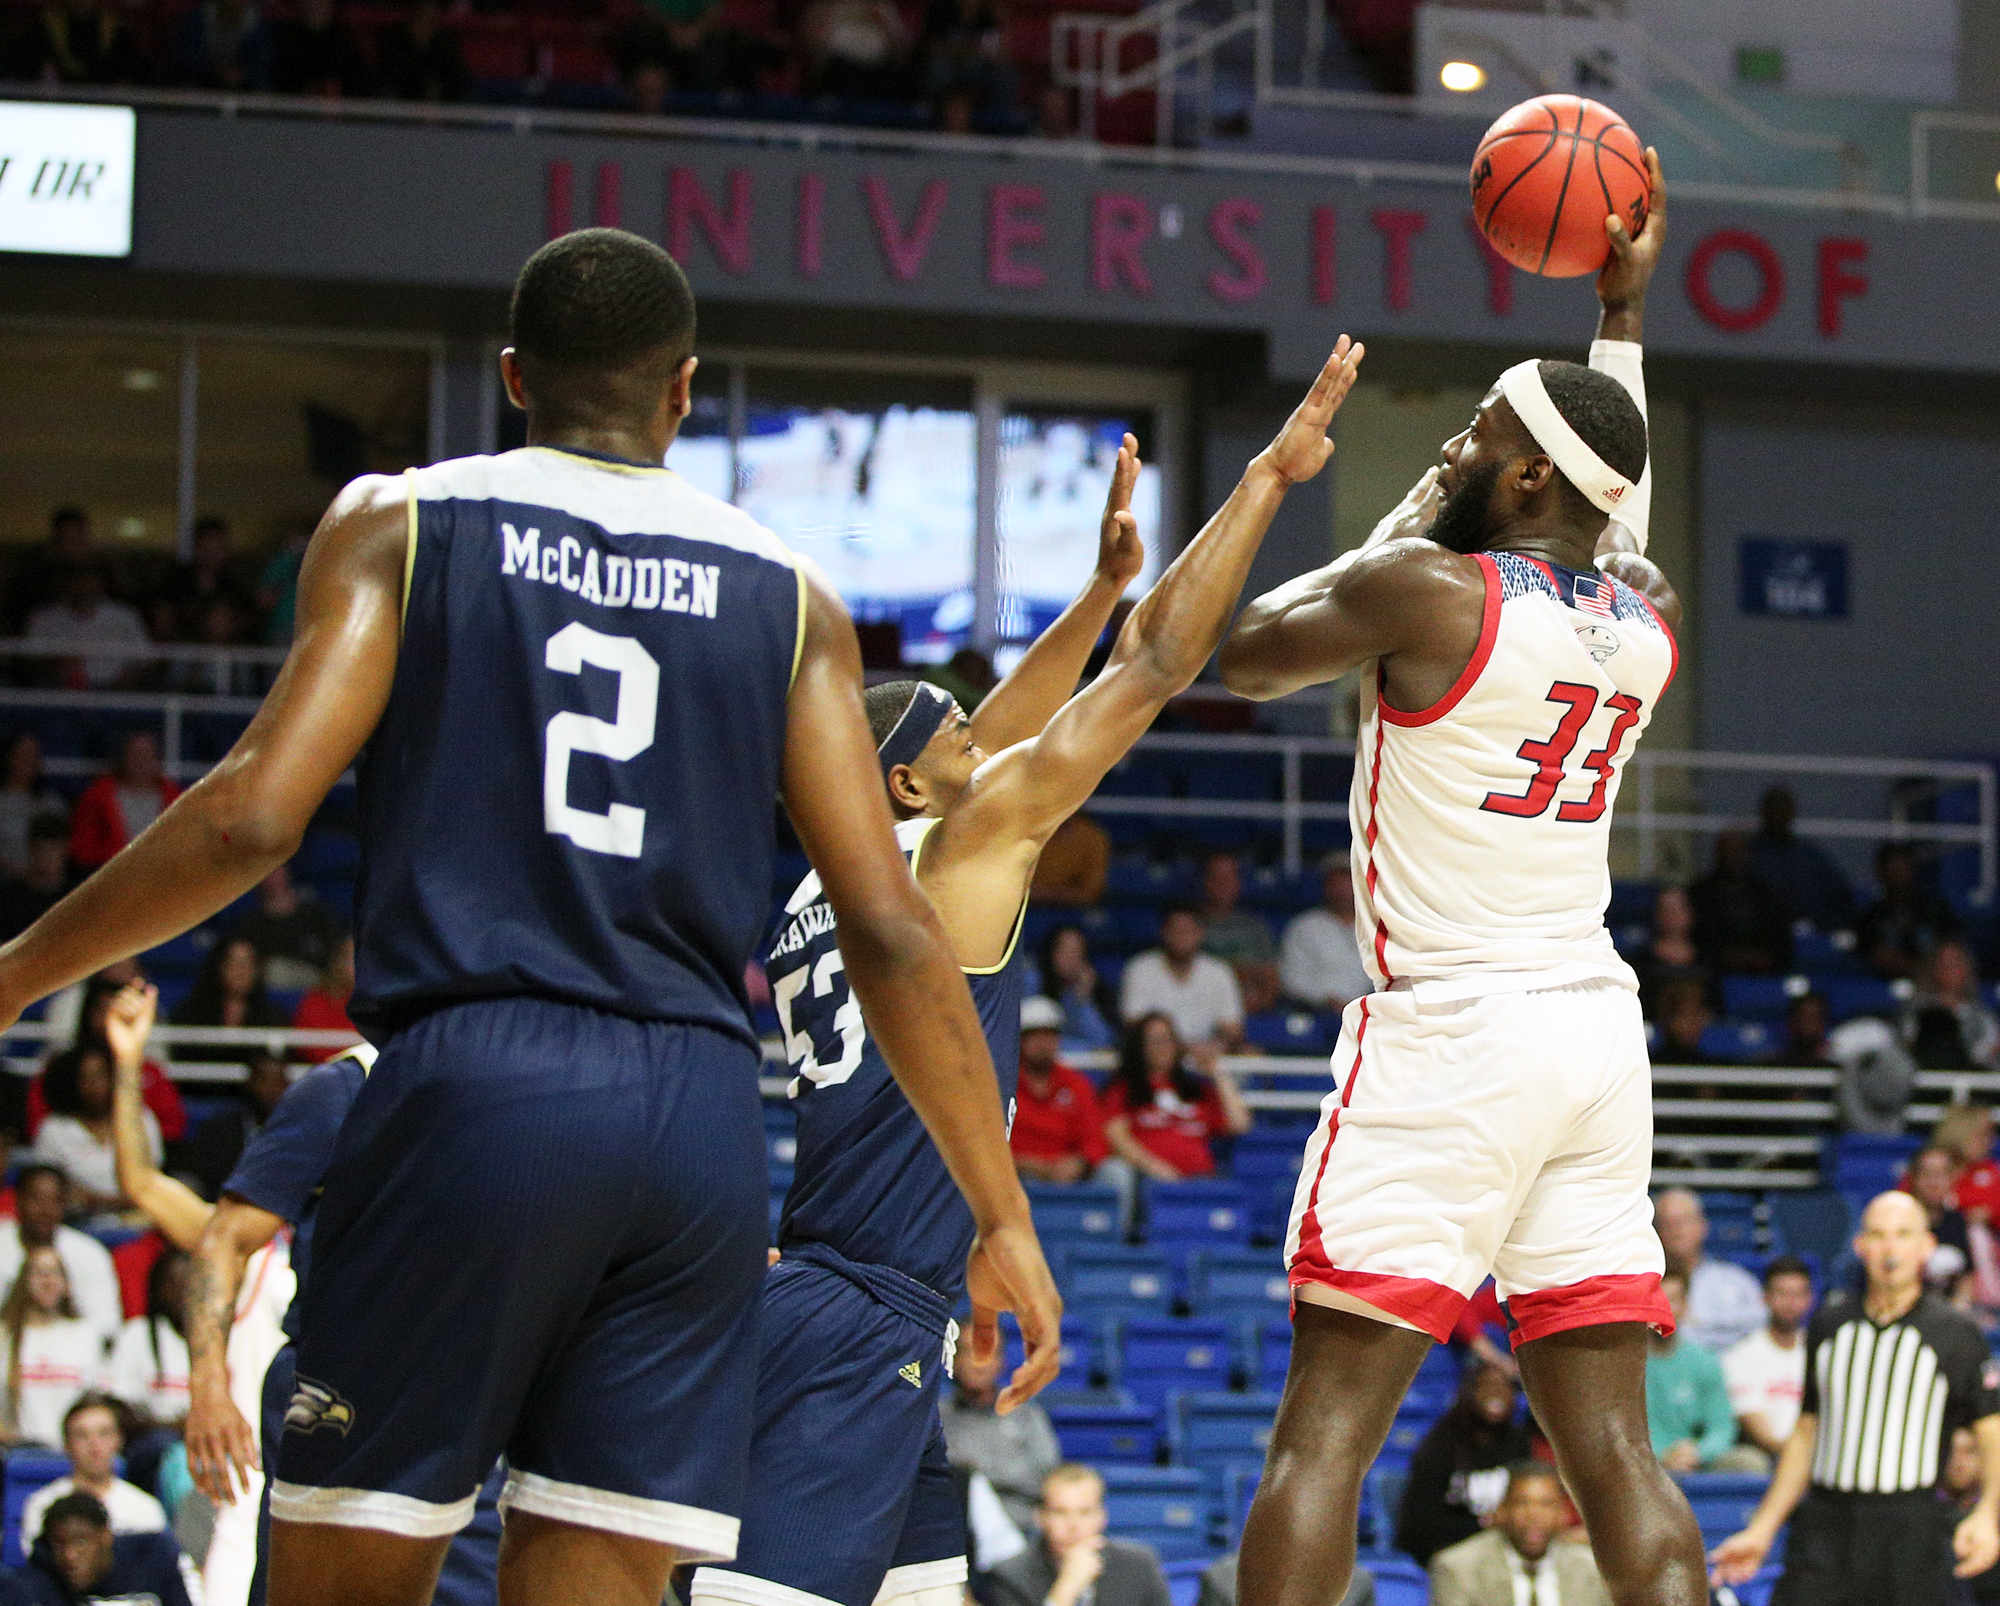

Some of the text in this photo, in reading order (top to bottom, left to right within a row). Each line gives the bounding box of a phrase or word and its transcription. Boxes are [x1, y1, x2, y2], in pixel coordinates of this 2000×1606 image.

[1685, 228, 1869, 337] OF
[544, 620, 660, 858] 2
[1479, 680, 1643, 823] 33
[772, 948, 866, 1100] 53
